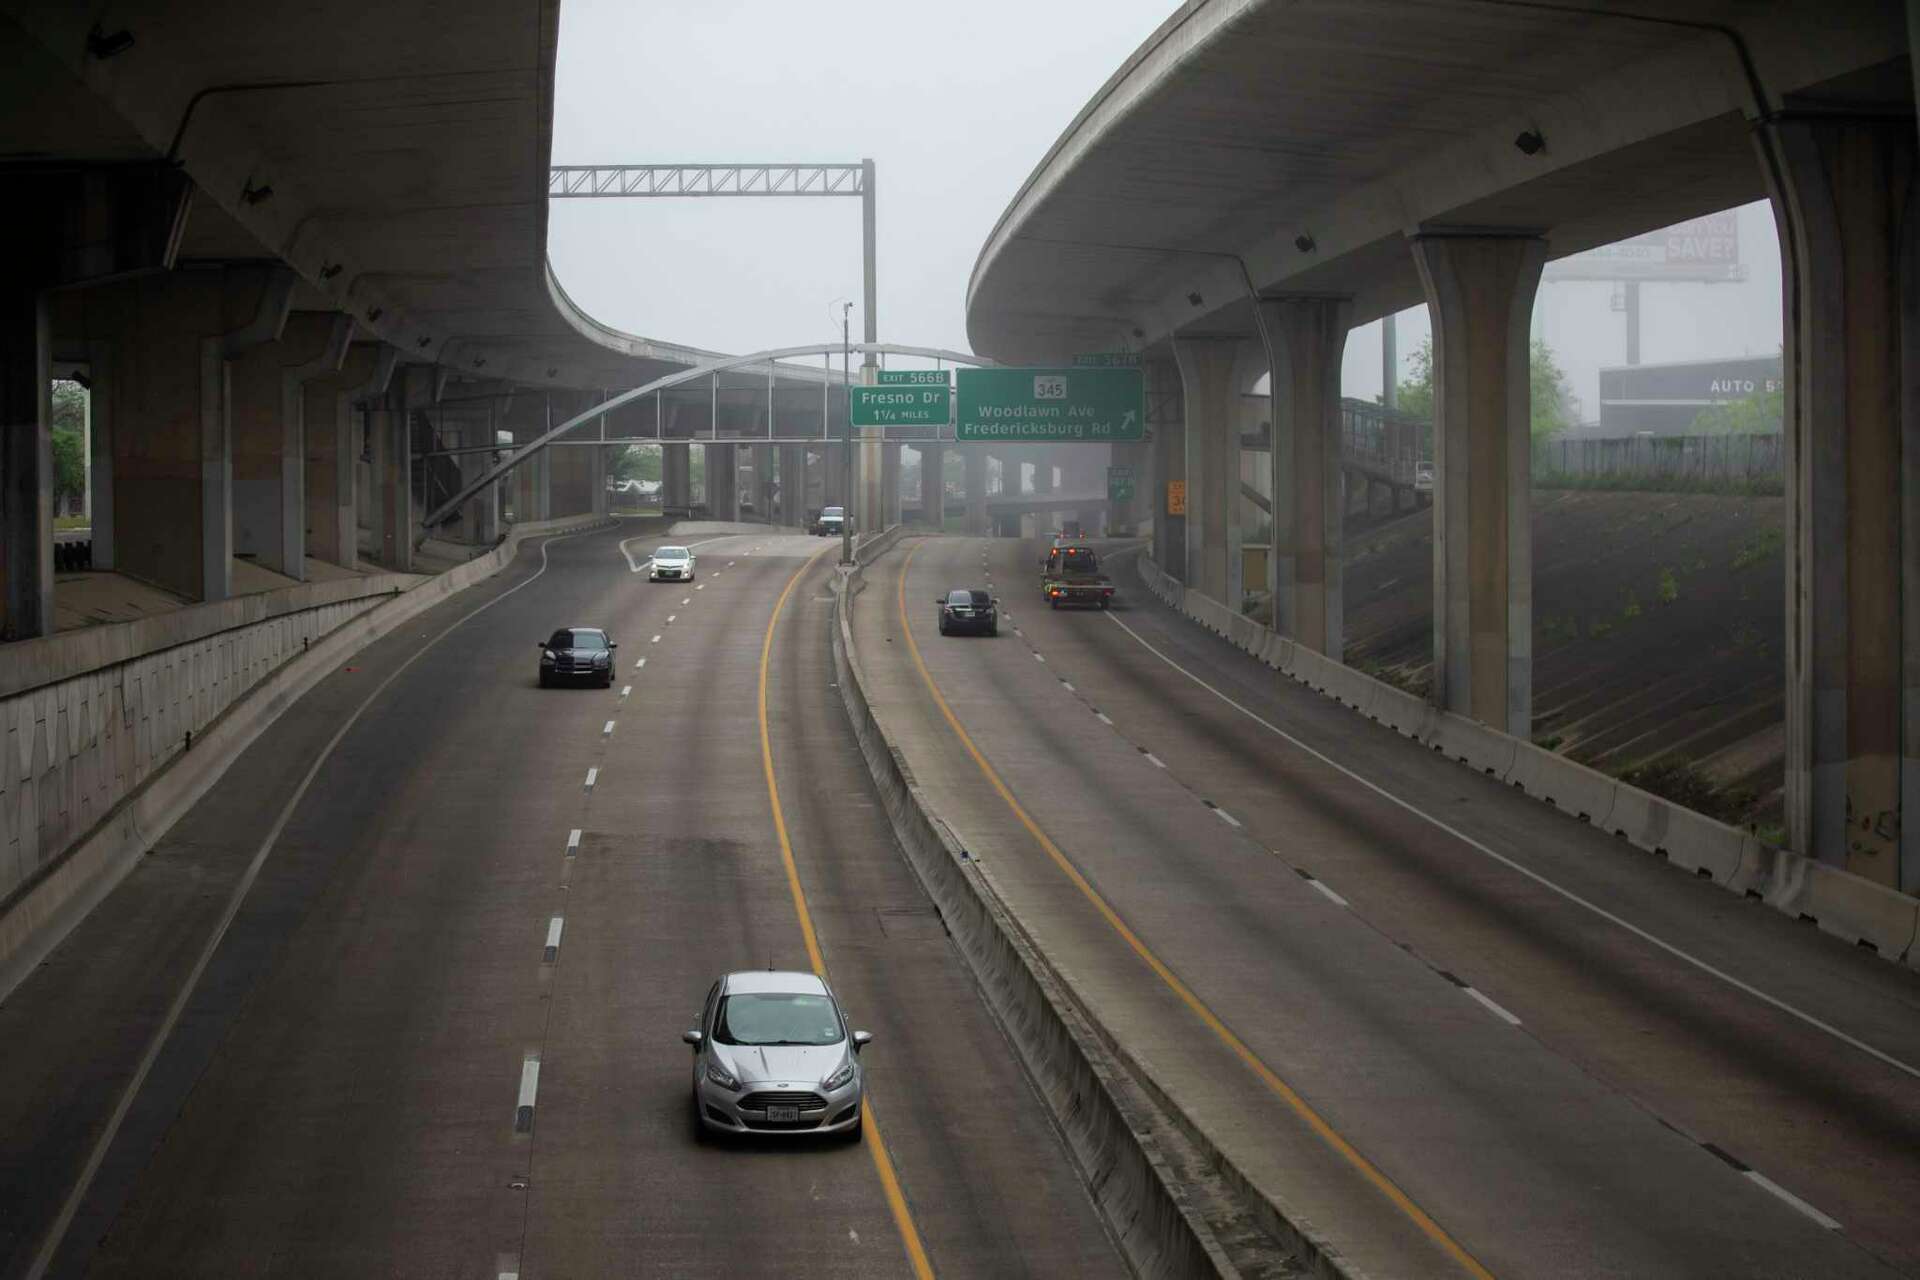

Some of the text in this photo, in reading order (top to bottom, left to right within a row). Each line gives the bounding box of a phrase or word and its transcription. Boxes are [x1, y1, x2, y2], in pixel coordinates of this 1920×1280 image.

[883, 372, 944, 383] EXIT 566B
[1038, 383, 1063, 397] 345
[1711, 379, 1754, 393] AUTO
[862, 391, 940, 404] Fresno Dr
[901, 410, 929, 419] MILES
[978, 405, 1095, 418] Woodlawn Ave
[964, 422, 1111, 437] Fredericksburg Rd
